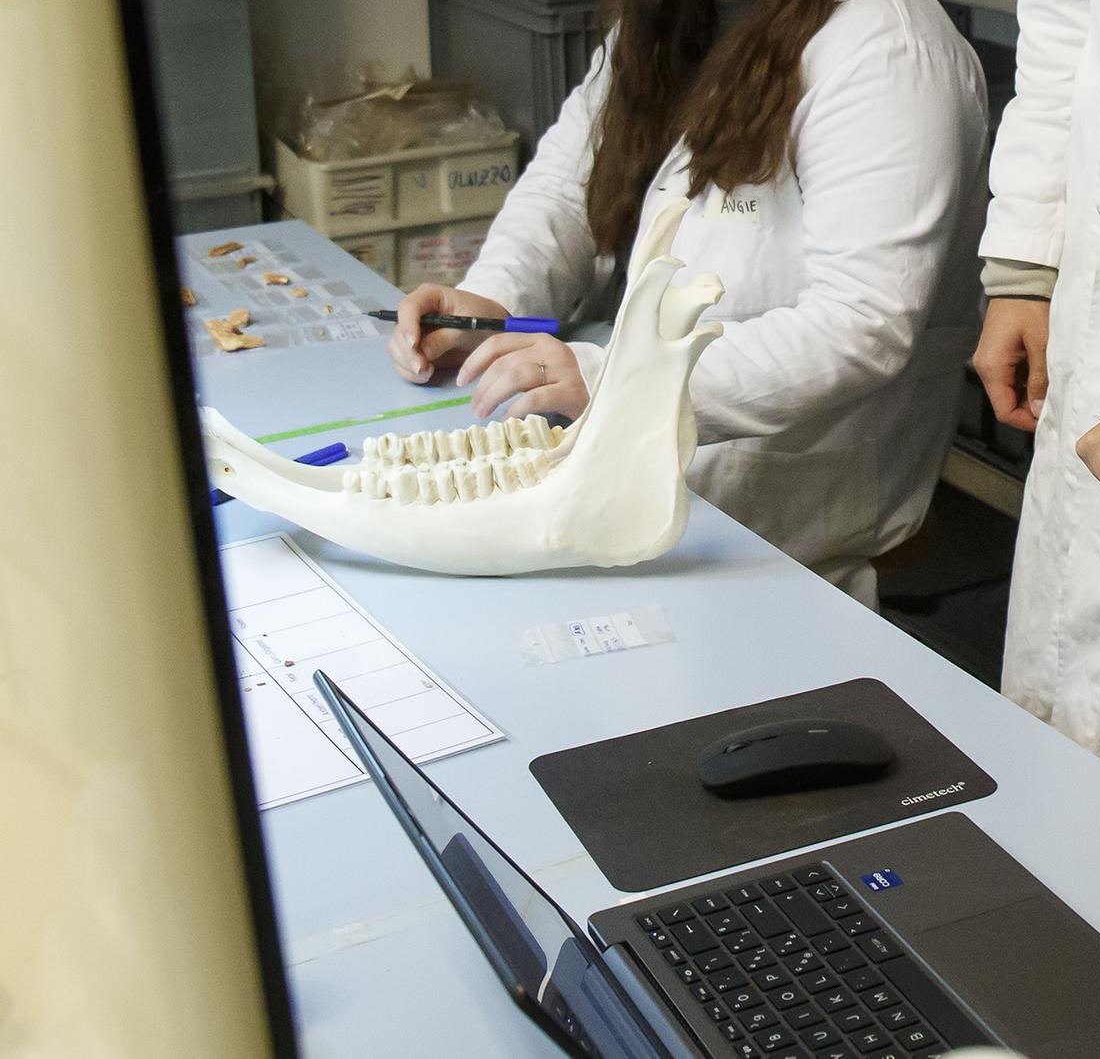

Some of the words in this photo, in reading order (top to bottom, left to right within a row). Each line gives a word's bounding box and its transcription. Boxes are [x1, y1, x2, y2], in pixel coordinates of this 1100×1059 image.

[815, 975, 828, 985] L
[828, 994, 844, 1004] K
[873, 991, 889, 1002] M
[753, 1013, 766, 1022] 9
[891, 1011, 906, 1022] N
[813, 1031, 828, 1041] U
[863, 1033, 879, 1044] H
[909, 1031, 925, 1042] B
